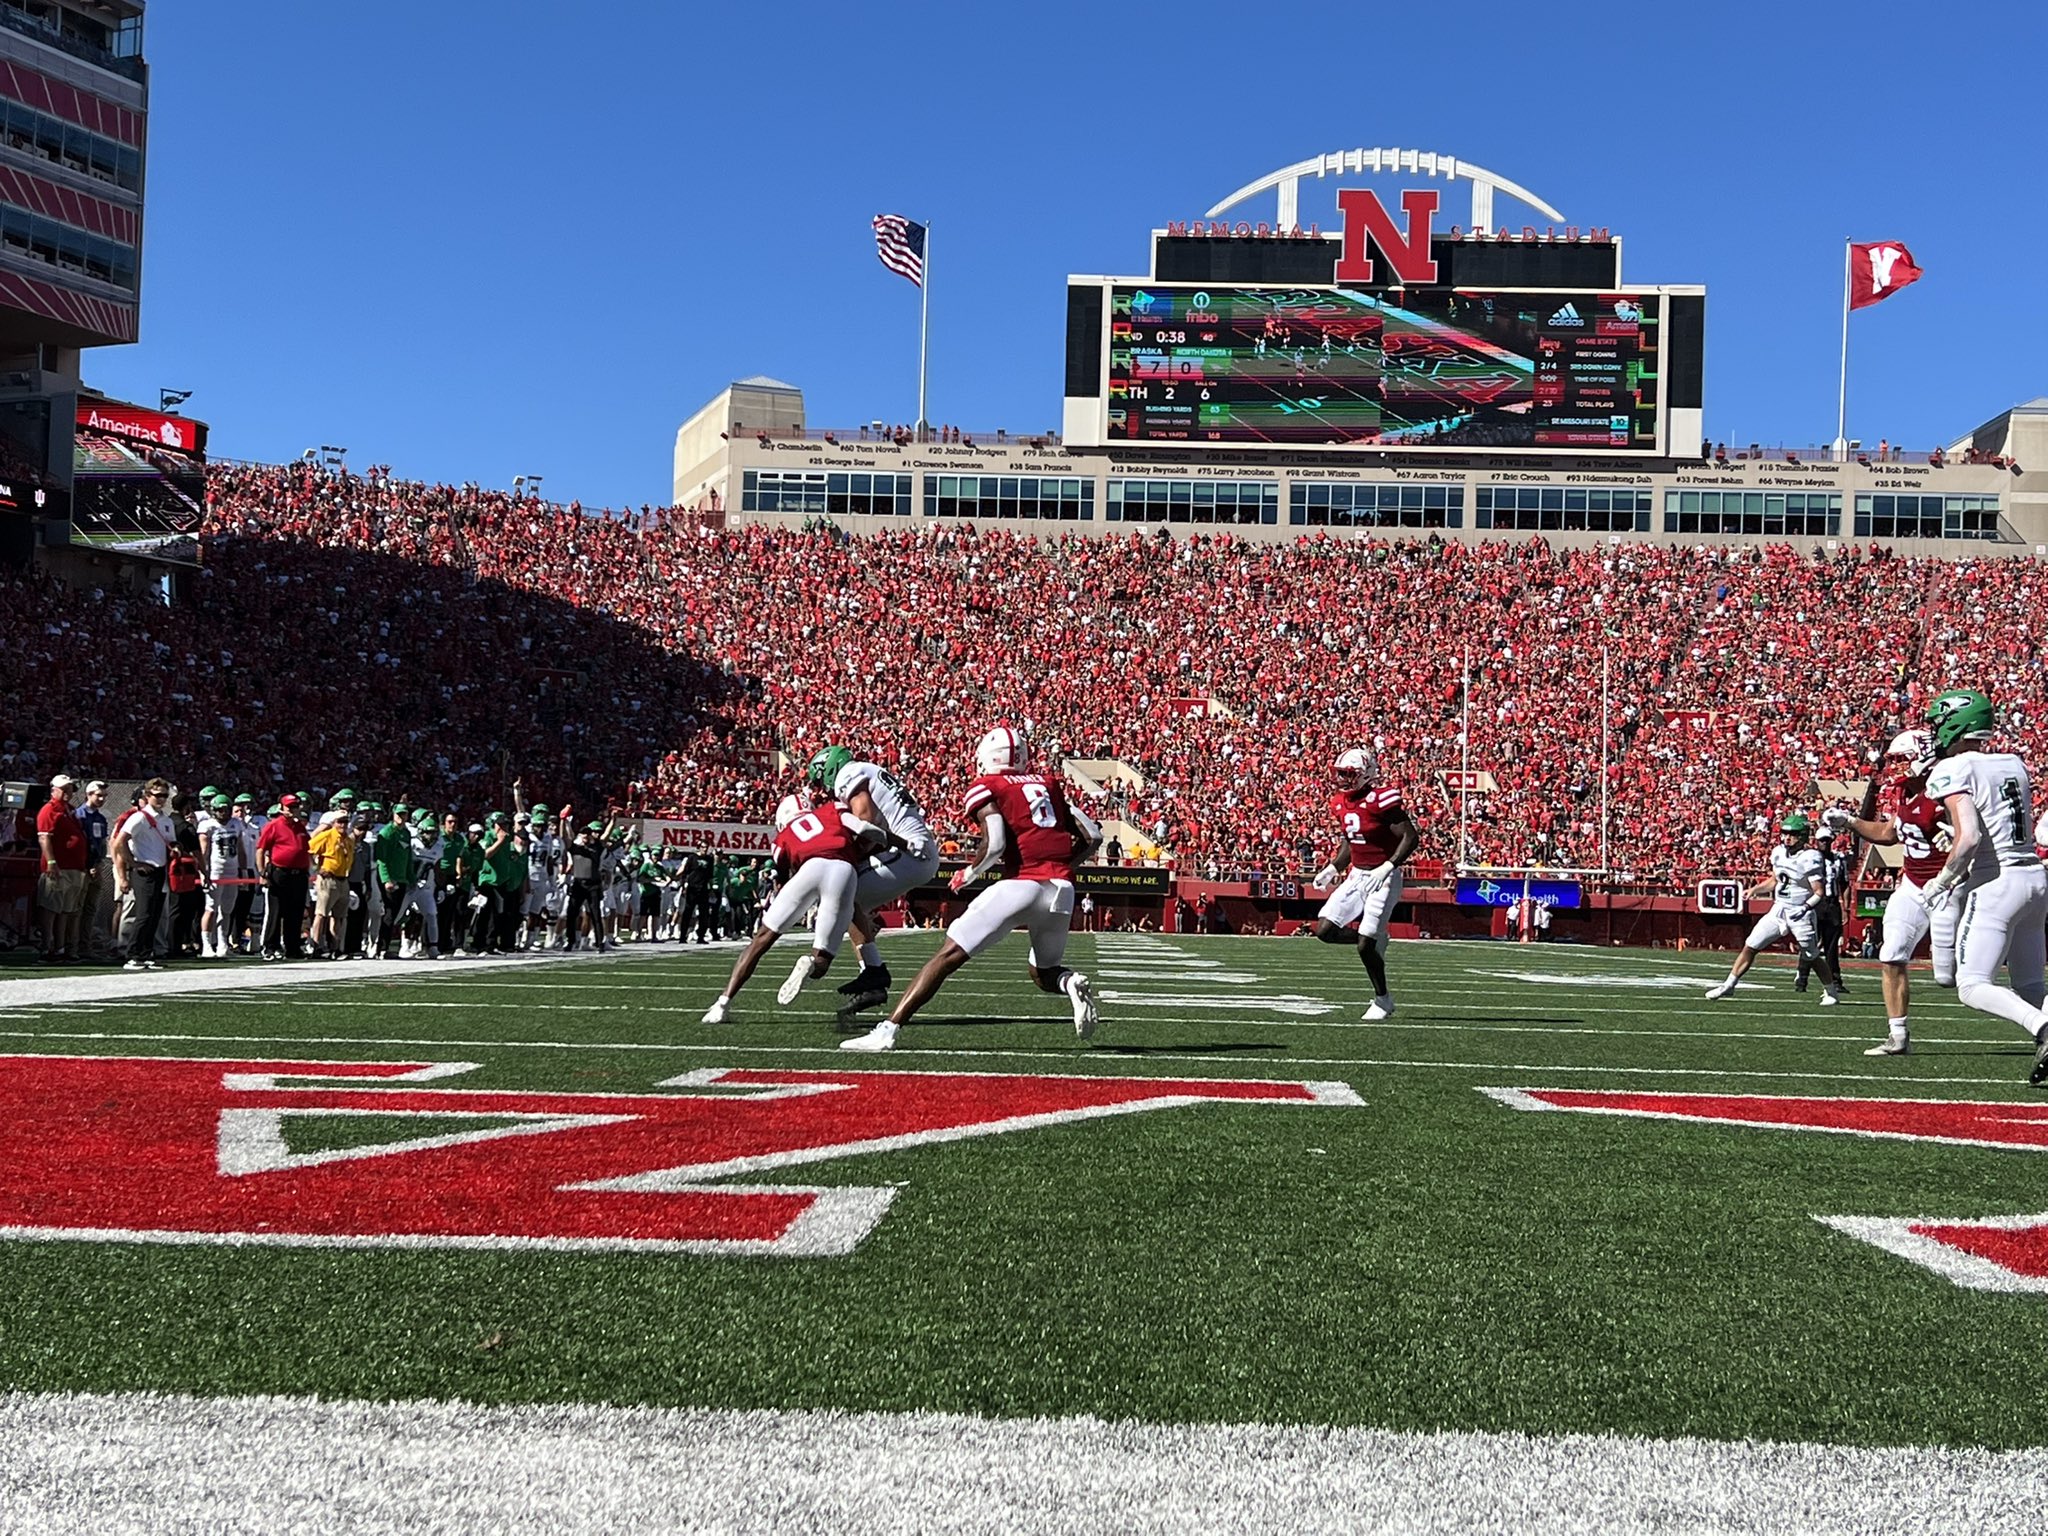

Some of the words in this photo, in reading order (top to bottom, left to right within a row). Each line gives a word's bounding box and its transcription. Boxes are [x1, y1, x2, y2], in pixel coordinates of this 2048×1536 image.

[1167, 221, 1323, 239] MEMORIAL
[1334, 188, 1440, 284] N
[1451, 225, 1609, 244] STADIUM
[1185, 309, 1219, 323] fnbo
[1548, 317, 1585, 327] adidas
[1156, 331, 1186, 344] 0:38
[1130, 348, 1163, 356] BRASKA
[1176, 349, 1200, 357] NORTH
[1201, 349, 1226, 357] DAKOTA
[1151, 361, 1160, 374] 7
[1181, 361, 1191, 374] 0
[1129, 387, 1148, 399] TH
[1165, 387, 1175, 400] 2
[1201, 388, 1210, 400] 6
[88, 410, 158, 443] Ameritas
[1591, 418, 1610, 426] STATE
[759, 443, 774, 451] Guy
[777, 443, 823, 451] Chamberlin
[945, 448, 973, 457] Johnny
[976, 449, 1007, 457] Rodgers
[1039, 450, 1056, 458] Rich
[825, 458, 852, 467] George
[1714, 464, 1746, 472] Wiegert
[1127, 466, 1151, 474] Bobby
[1153, 467, 1188, 475] Reynolds
[1214, 468, 1235, 476] Larry
[1440, 472, 1466, 481] Taylor
[1520, 474, 1550, 482] Crouch
[1583, 476, 1634, 484] Ndamukong
[1775, 479, 1803, 487] Wayne
[1805, 480, 1835, 488] Meylan
[1021, 783, 1057, 828] 8
[1999, 777, 2027, 846] 1
[790, 812, 825, 842] 0
[1344, 812, 1366, 845] 2
[662, 827, 772, 850] NEBRASKA
[1088, 875, 1110, 884] THAT'S
[1112, 877, 1129, 885] WHO
[1131, 877, 1141, 885] WE
[1778, 872, 1791, 899] 2
[1705, 886, 1735, 908] 40
